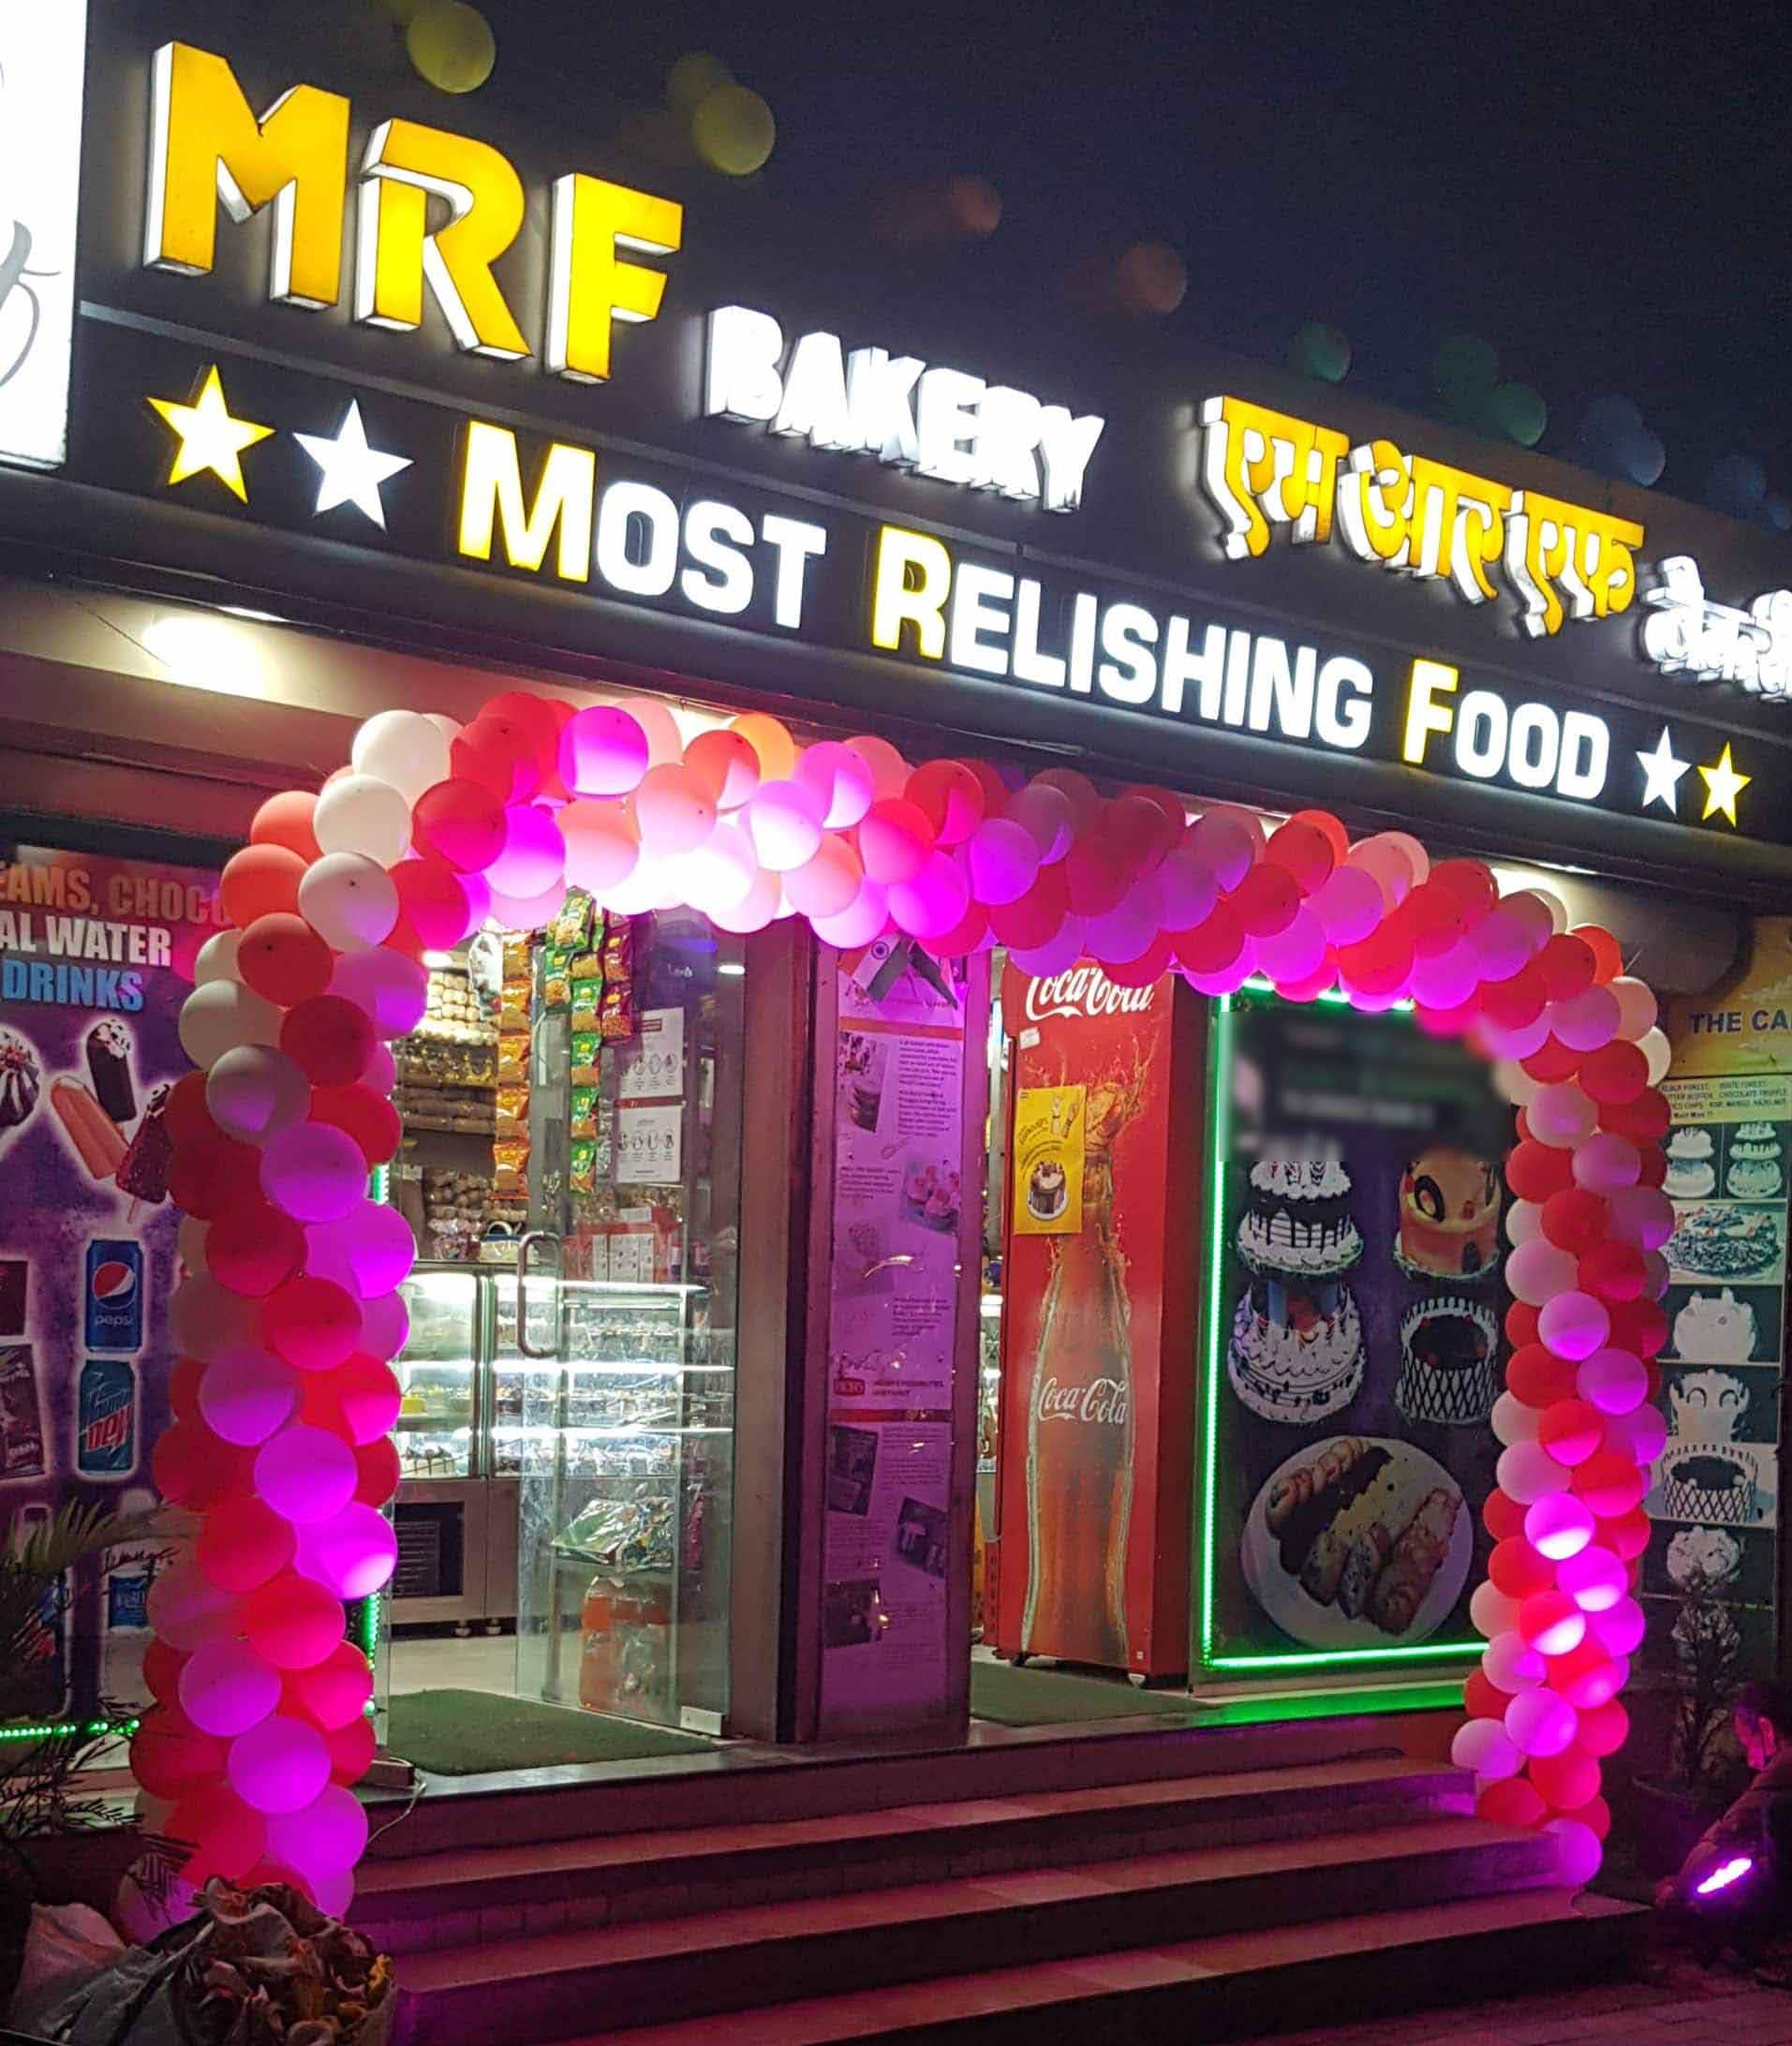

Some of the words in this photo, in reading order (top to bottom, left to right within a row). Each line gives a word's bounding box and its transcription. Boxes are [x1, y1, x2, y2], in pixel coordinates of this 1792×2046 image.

[143, 40, 683, 385] MRF
[704, 304, 1105, 514] BAKERY
[46, 914, 171, 968] WATER
[2, 958, 144, 1012] DRINKS
[1687, 1012, 1742, 1033] THE
[1753, 1008, 1792, 1031] CA
